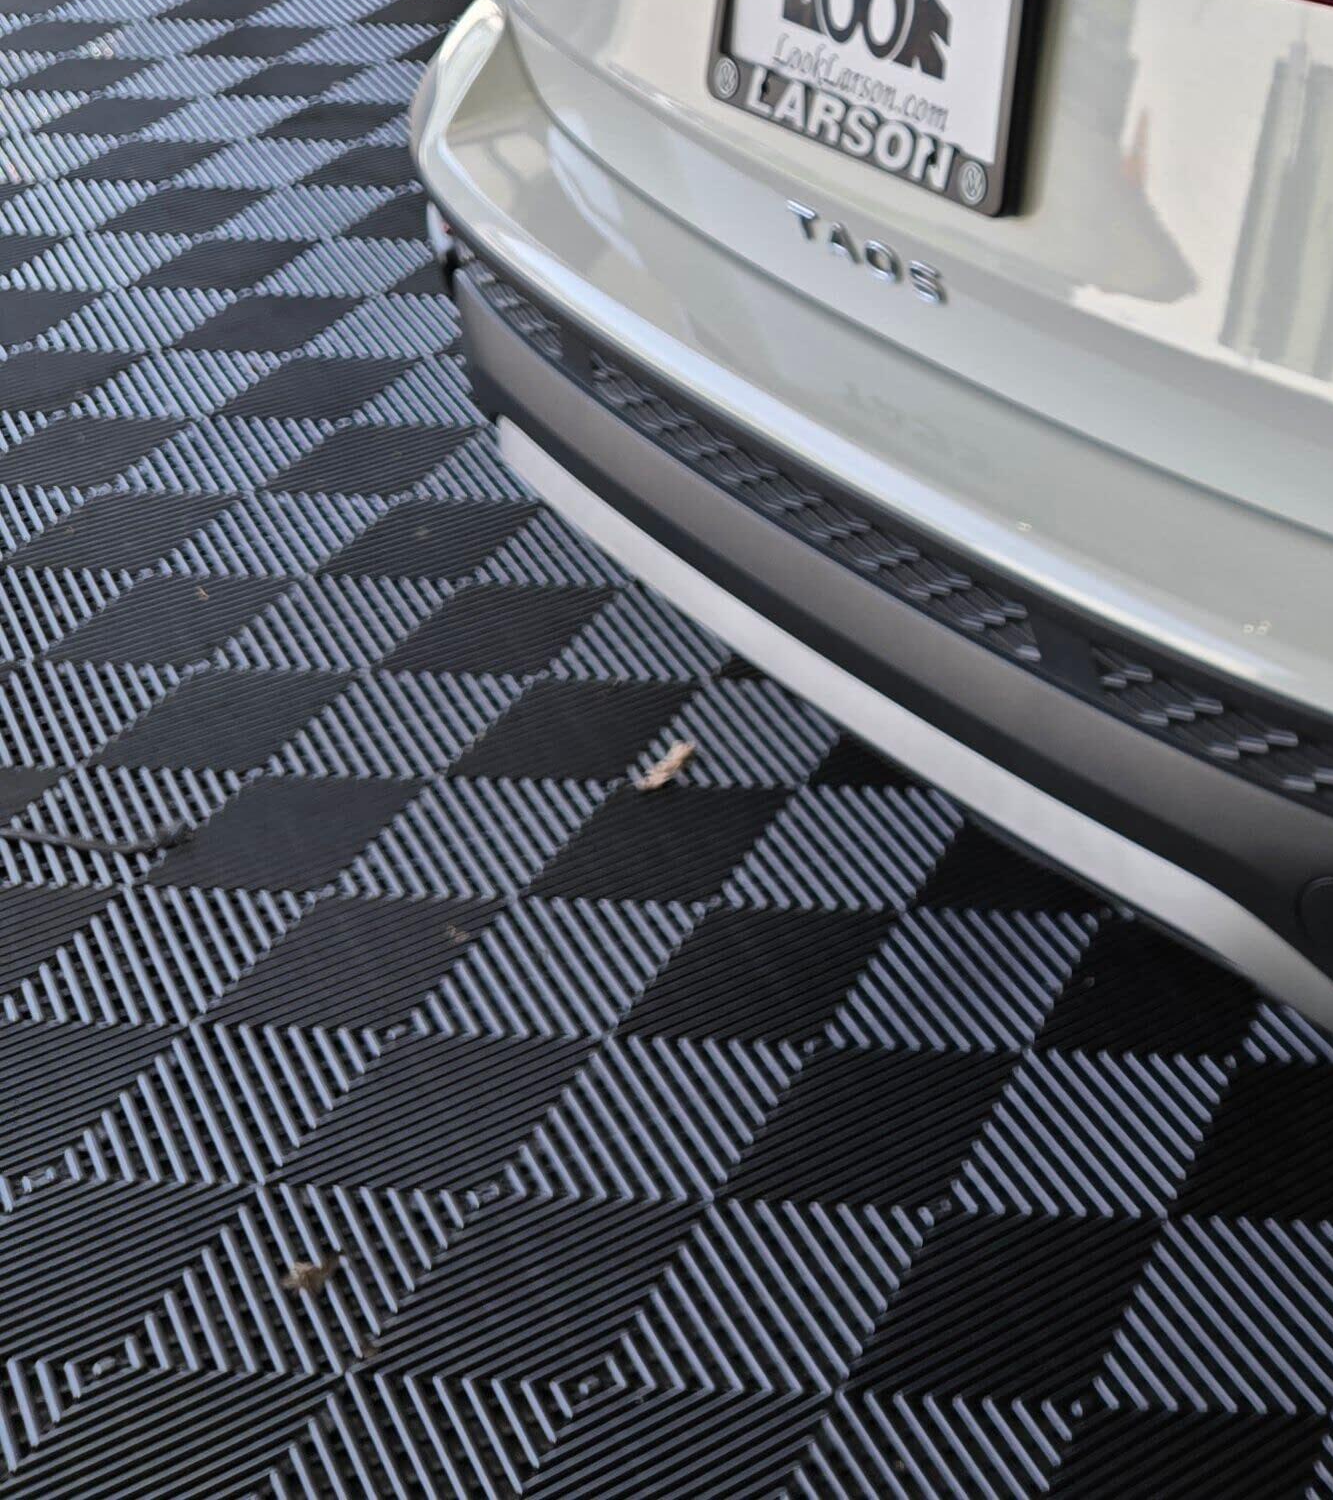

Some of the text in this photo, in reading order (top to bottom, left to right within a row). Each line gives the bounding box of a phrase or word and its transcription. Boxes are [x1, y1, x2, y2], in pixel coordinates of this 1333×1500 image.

[748, 66, 955, 191] LARSON
[772, 32, 950, 133] LookLarson.com
[785, 199, 948, 304] TAOS
